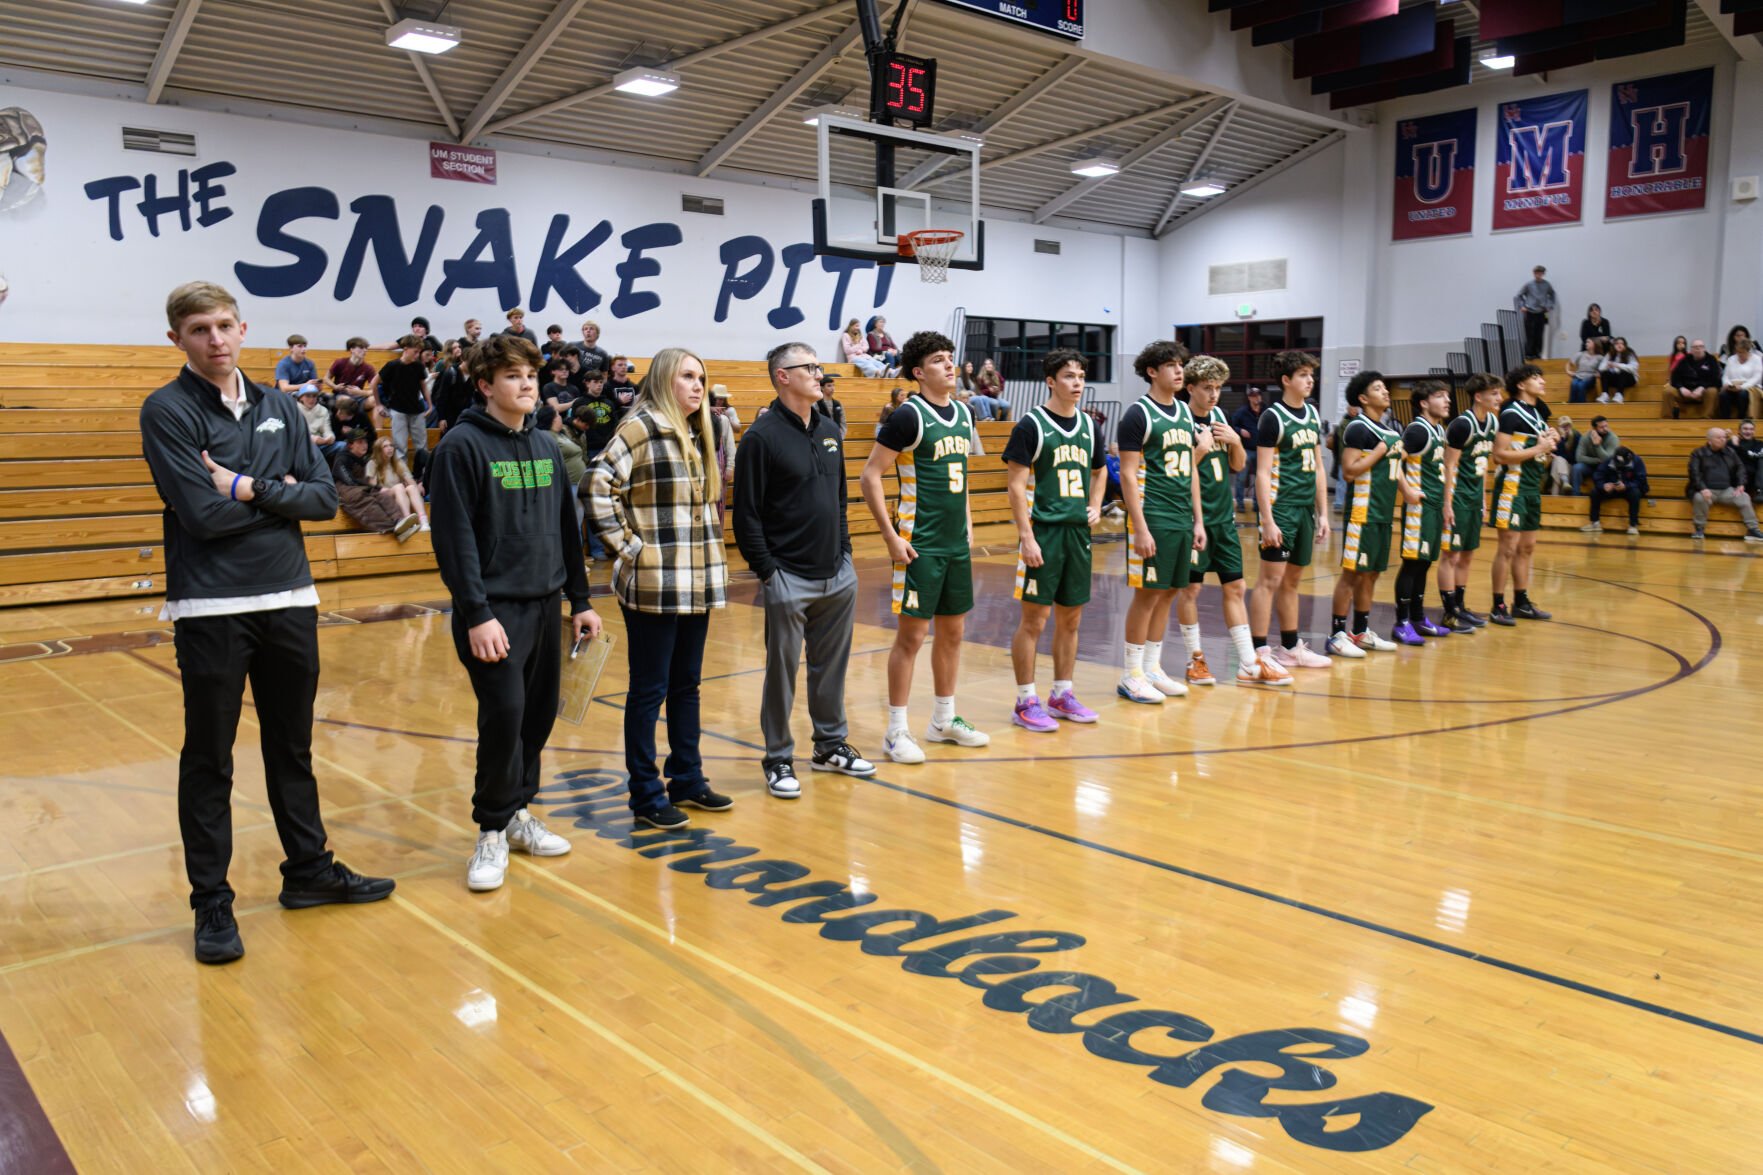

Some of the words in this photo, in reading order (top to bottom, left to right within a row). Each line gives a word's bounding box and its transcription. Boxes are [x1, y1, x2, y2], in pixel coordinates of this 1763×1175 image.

[999, 2, 1028, 19] MATCH
[1057, 20, 1083, 34] SCORE
[887, 62, 926, 113] 35
[1627, 101, 1691, 178] H
[431, 149, 448, 159] UM
[450, 151, 495, 164] STUDENT
[1506, 120, 1573, 193] M
[442, 161, 485, 174] SECTION
[1412, 138, 1457, 204] U
[1610, 177, 1702, 198] HONORABLE
[1504, 193, 1571, 210] MINDFUL
[1408, 206, 1457, 221] UNITED
[84, 161, 237, 241] THE
[234, 186, 682, 319] SNAKE
[1162, 428, 1193, 450] ARGO
[1164, 450, 1191, 478] 24
[1210, 457, 1223, 482] 1
[947, 462, 964, 494] 5
[1057, 469, 1085, 498] 12
[1145, 566, 1157, 582] A
[1025, 578, 1038, 596] A
[905, 590, 919, 609] A
